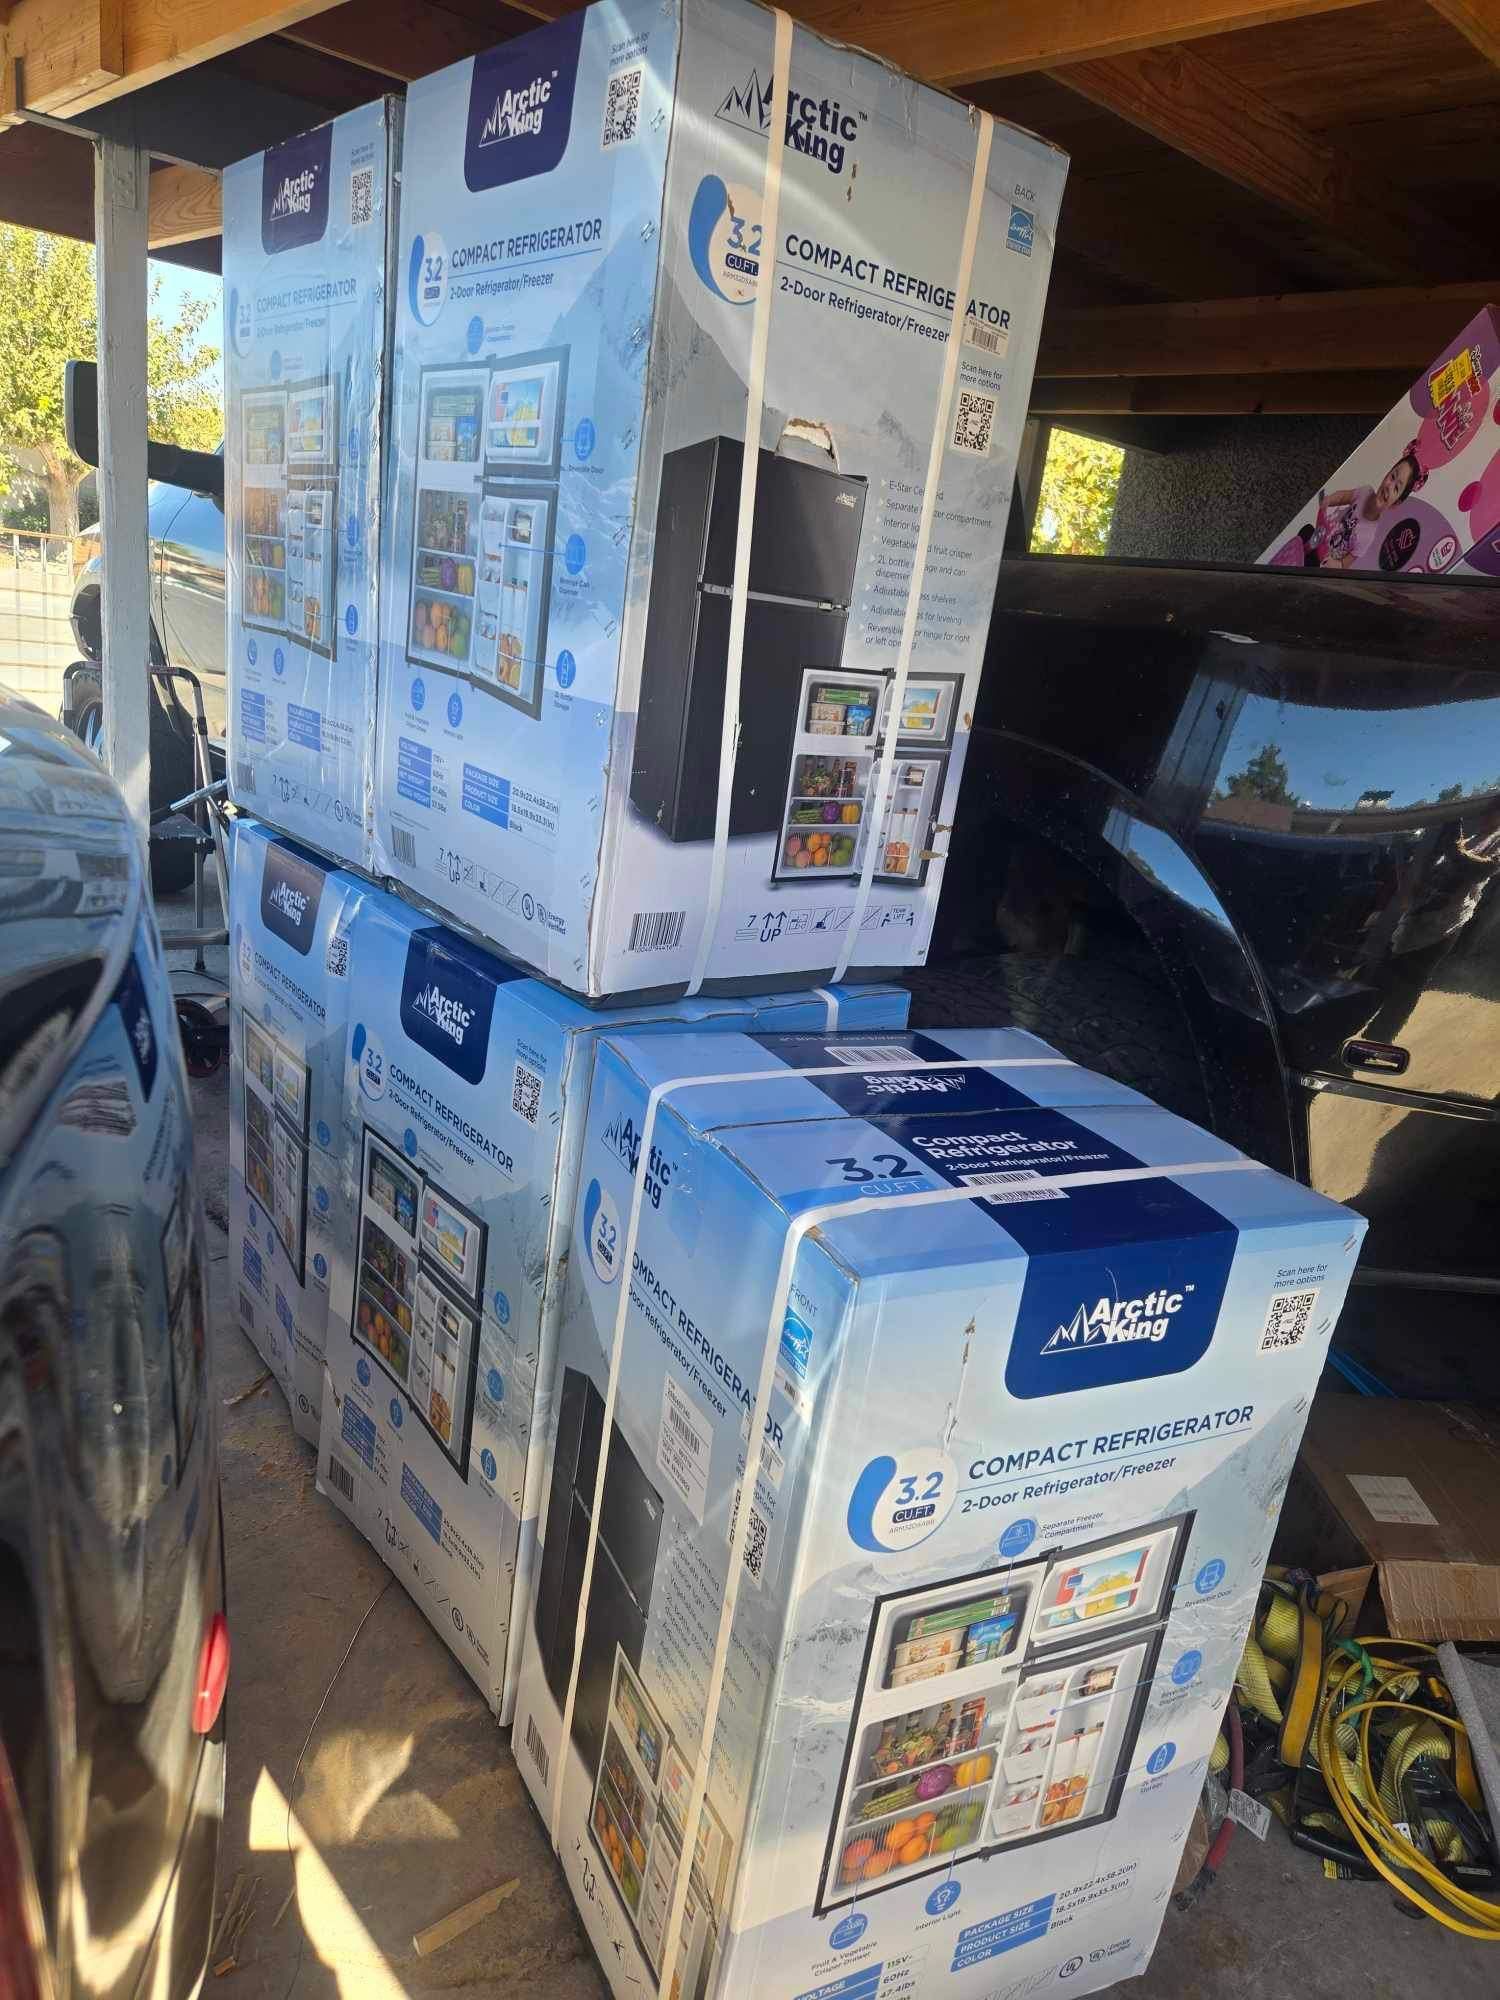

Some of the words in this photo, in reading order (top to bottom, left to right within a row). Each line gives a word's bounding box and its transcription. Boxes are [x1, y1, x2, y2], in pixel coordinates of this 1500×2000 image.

[501, 78, 551, 117] Arctic
[508, 107, 543, 136] King
[283, 171, 315, 197] Arctic
[1014, 185, 1037, 202] BACK
[288, 193, 311, 214] King
[452, 241, 504, 268] COMPACT
[507, 218, 602, 258] REFRIGERATOR
[727, 216, 763, 256] 3.2
[425, 256, 442, 283] 3.2
[786, 234, 879, 284] COMPACT
[883, 268, 1011, 329] REFRIGEATOR
[256, 292, 291, 314] COMPACT
[292, 279, 357, 306] REFRIGERATOR
[450, 286, 475, 300] 2-Door
[475, 272, 554, 297] Refrigerator/Freezer
[780, 276, 827, 304] 2-Door
[828, 292, 950, 344] Refrigerator/Freezer
[960, 372, 977, 384] more
[977, 377, 1001, 391] options
[961, 361, 977, 374] Scan
[978, 366, 993, 378] here
[993, 369, 1003, 381] for
[887, 500, 918, 514] Separate
[946, 512, 992, 529] compartment
[884, 517, 909, 531] Interior
[279, 881, 306, 911] Arctic
[284, 900, 301, 926] King
[760, 929, 781, 943] UP
[254, 952, 281, 980] COMPACT
[281, 970, 327, 1020] REFRIGERATOR
[430, 986, 472, 1027] Arctic
[436, 1012, 463, 1045] King
[366, 1048, 383, 1074] 3.2
[389, 1063, 434, 1111] COMPACT
[435, 1099, 514, 1174] REFRIGERATOR
[410, 1107, 475, 1167] Refrigerator/Freezer
[911, 1130, 1028, 1148] Compact
[925, 1138, 1079, 1160] Refrigerator
[621, 1118, 671, 1186] Artic
[946, 1160, 992, 1172] 2-Door
[993, 1151, 1110, 1169] Refrigerator/Freezer
[826, 1154, 921, 1182] 3.2
[628, 1155, 662, 1210] Kng
[860, 1180, 930, 1196] CU.FT.
[599, 1213, 617, 1251] 3.2
[1274, 1278, 1294, 1289] more
[1296, 1274, 1325, 1288] options
[1277, 1267, 1295, 1279] Scan
[1297, 1265, 1314, 1276] here
[1315, 1263, 1328, 1275] for
[791, 1283, 819, 1317] FRONT
[1088, 1289, 1184, 1326] Arctic
[1105, 1318, 1169, 1344] King
[632, 1249, 677, 1317] OMPACT
[678, 1310, 783, 1449] REFRIGERAOR
[644, 1305, 727, 1418] Refrigerator/Freezer
[968, 1439, 1088, 1481] COMPACT
[1092, 1405, 1253, 1456] REFRIGERATOR
[895, 1471, 944, 1506] 3.2
[961, 1488, 1021, 1515] 2-Door
[1023, 1454, 1176, 1500] Refrigerator/Freezer
[1042, 1515, 1073, 1532] Separate
[1074, 1511, 1104, 1526] Freezer
[1043, 1522, 1096, 1540] Compartment
[914, 1916, 941, 1931] Interior
[964, 1914, 1011, 1939] PACKAGE
[1012, 1906, 1035, 1921] SIZE
[1050, 1914, 1074, 1930] Black
[839, 1940, 878, 1961] Vegetable
[960, 1929, 1007, 1954] PRODUCT
[1009, 1920, 1031, 1936] SIZE
[842, 1950, 872, 1968] Drawer
[956, 1948, 993, 1969] COLOR
[883, 1969, 910, 1984] 60Hz
